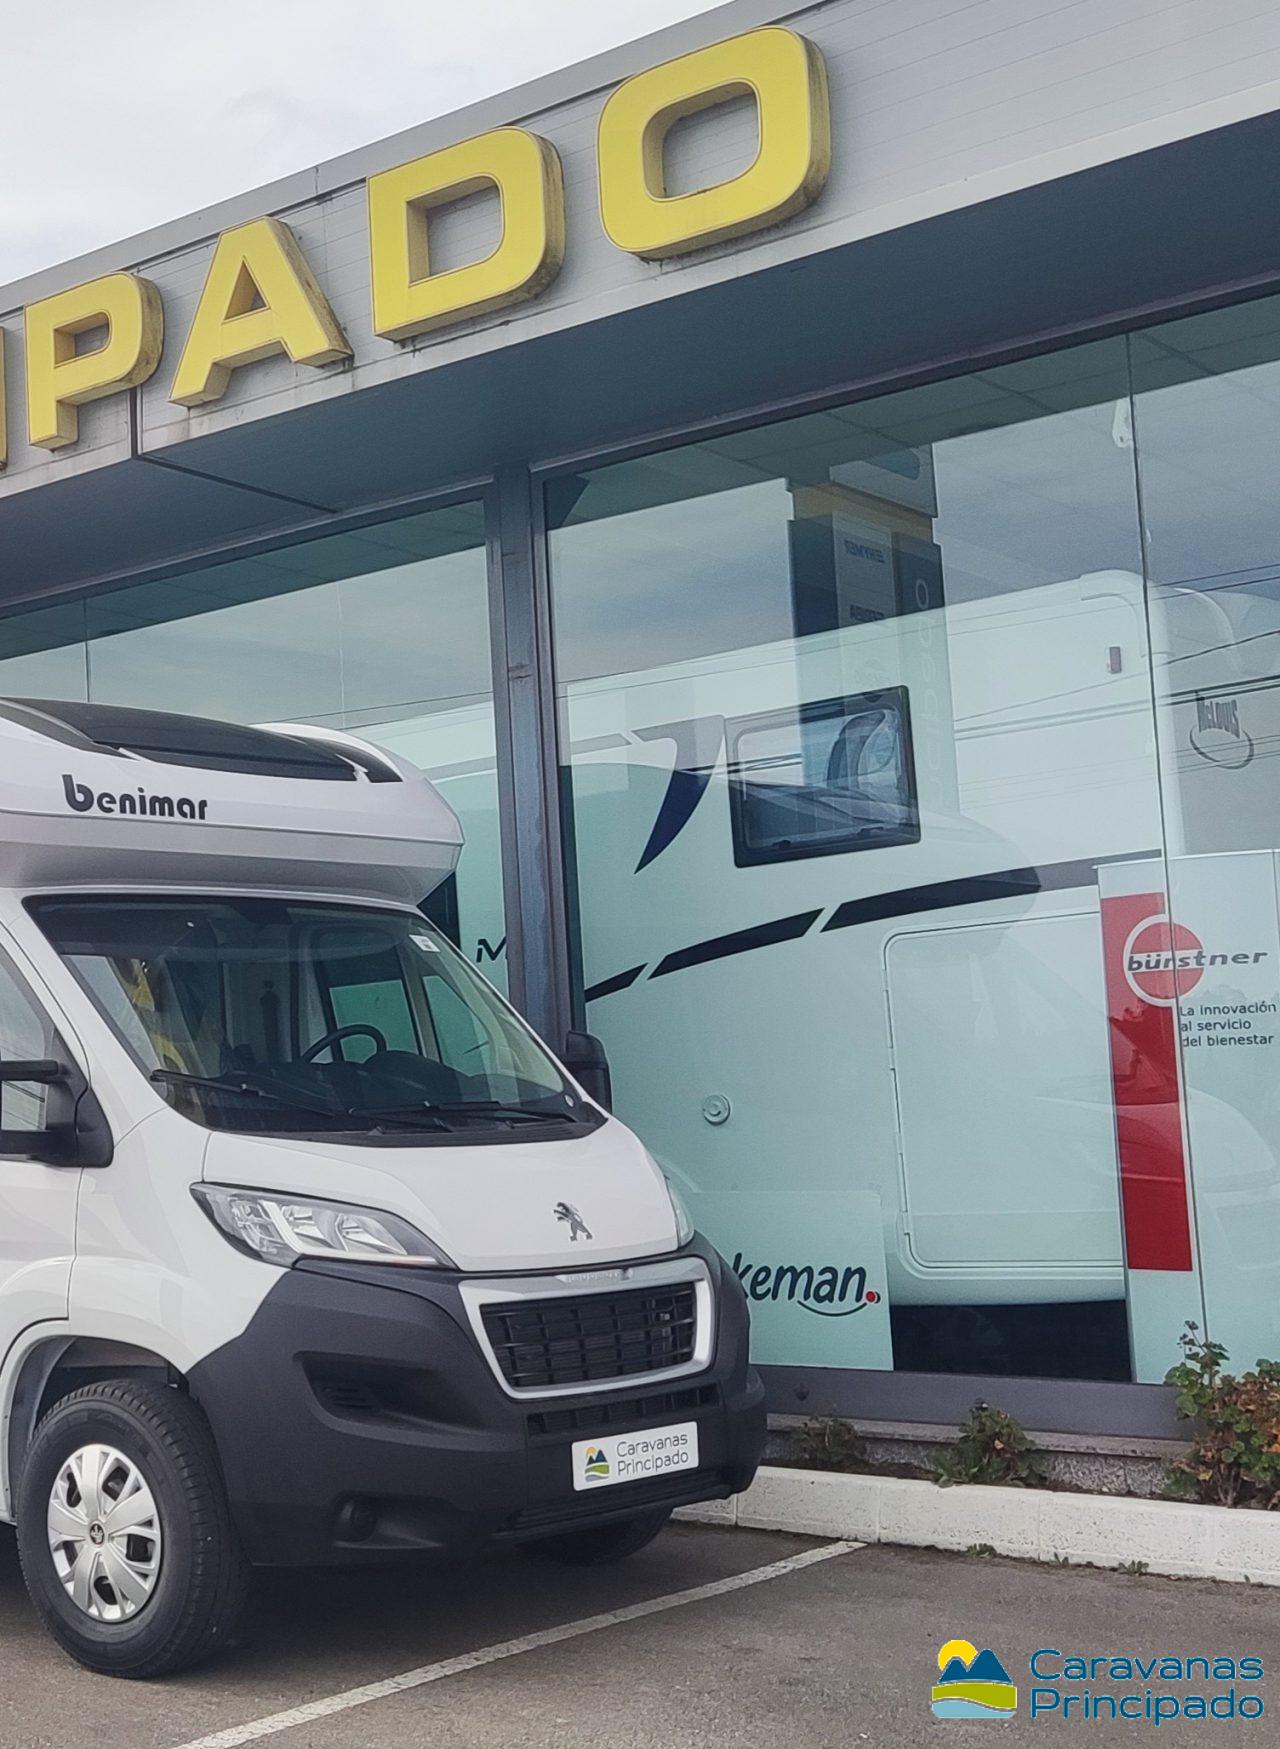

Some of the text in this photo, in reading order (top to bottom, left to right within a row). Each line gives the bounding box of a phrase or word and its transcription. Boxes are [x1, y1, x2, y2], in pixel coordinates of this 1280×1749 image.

[61, 774, 208, 820] benimar
[1127, 950, 1268, 972] bürstner
[1180, 1001, 1277, 1017] La innovación
[1181, 1018, 1252, 1032] al servicio
[1182, 1034, 1275, 1048] del bienestar
[616, 1433, 688, 1457] Caravanas
[617, 1450, 689, 1476] Principado
